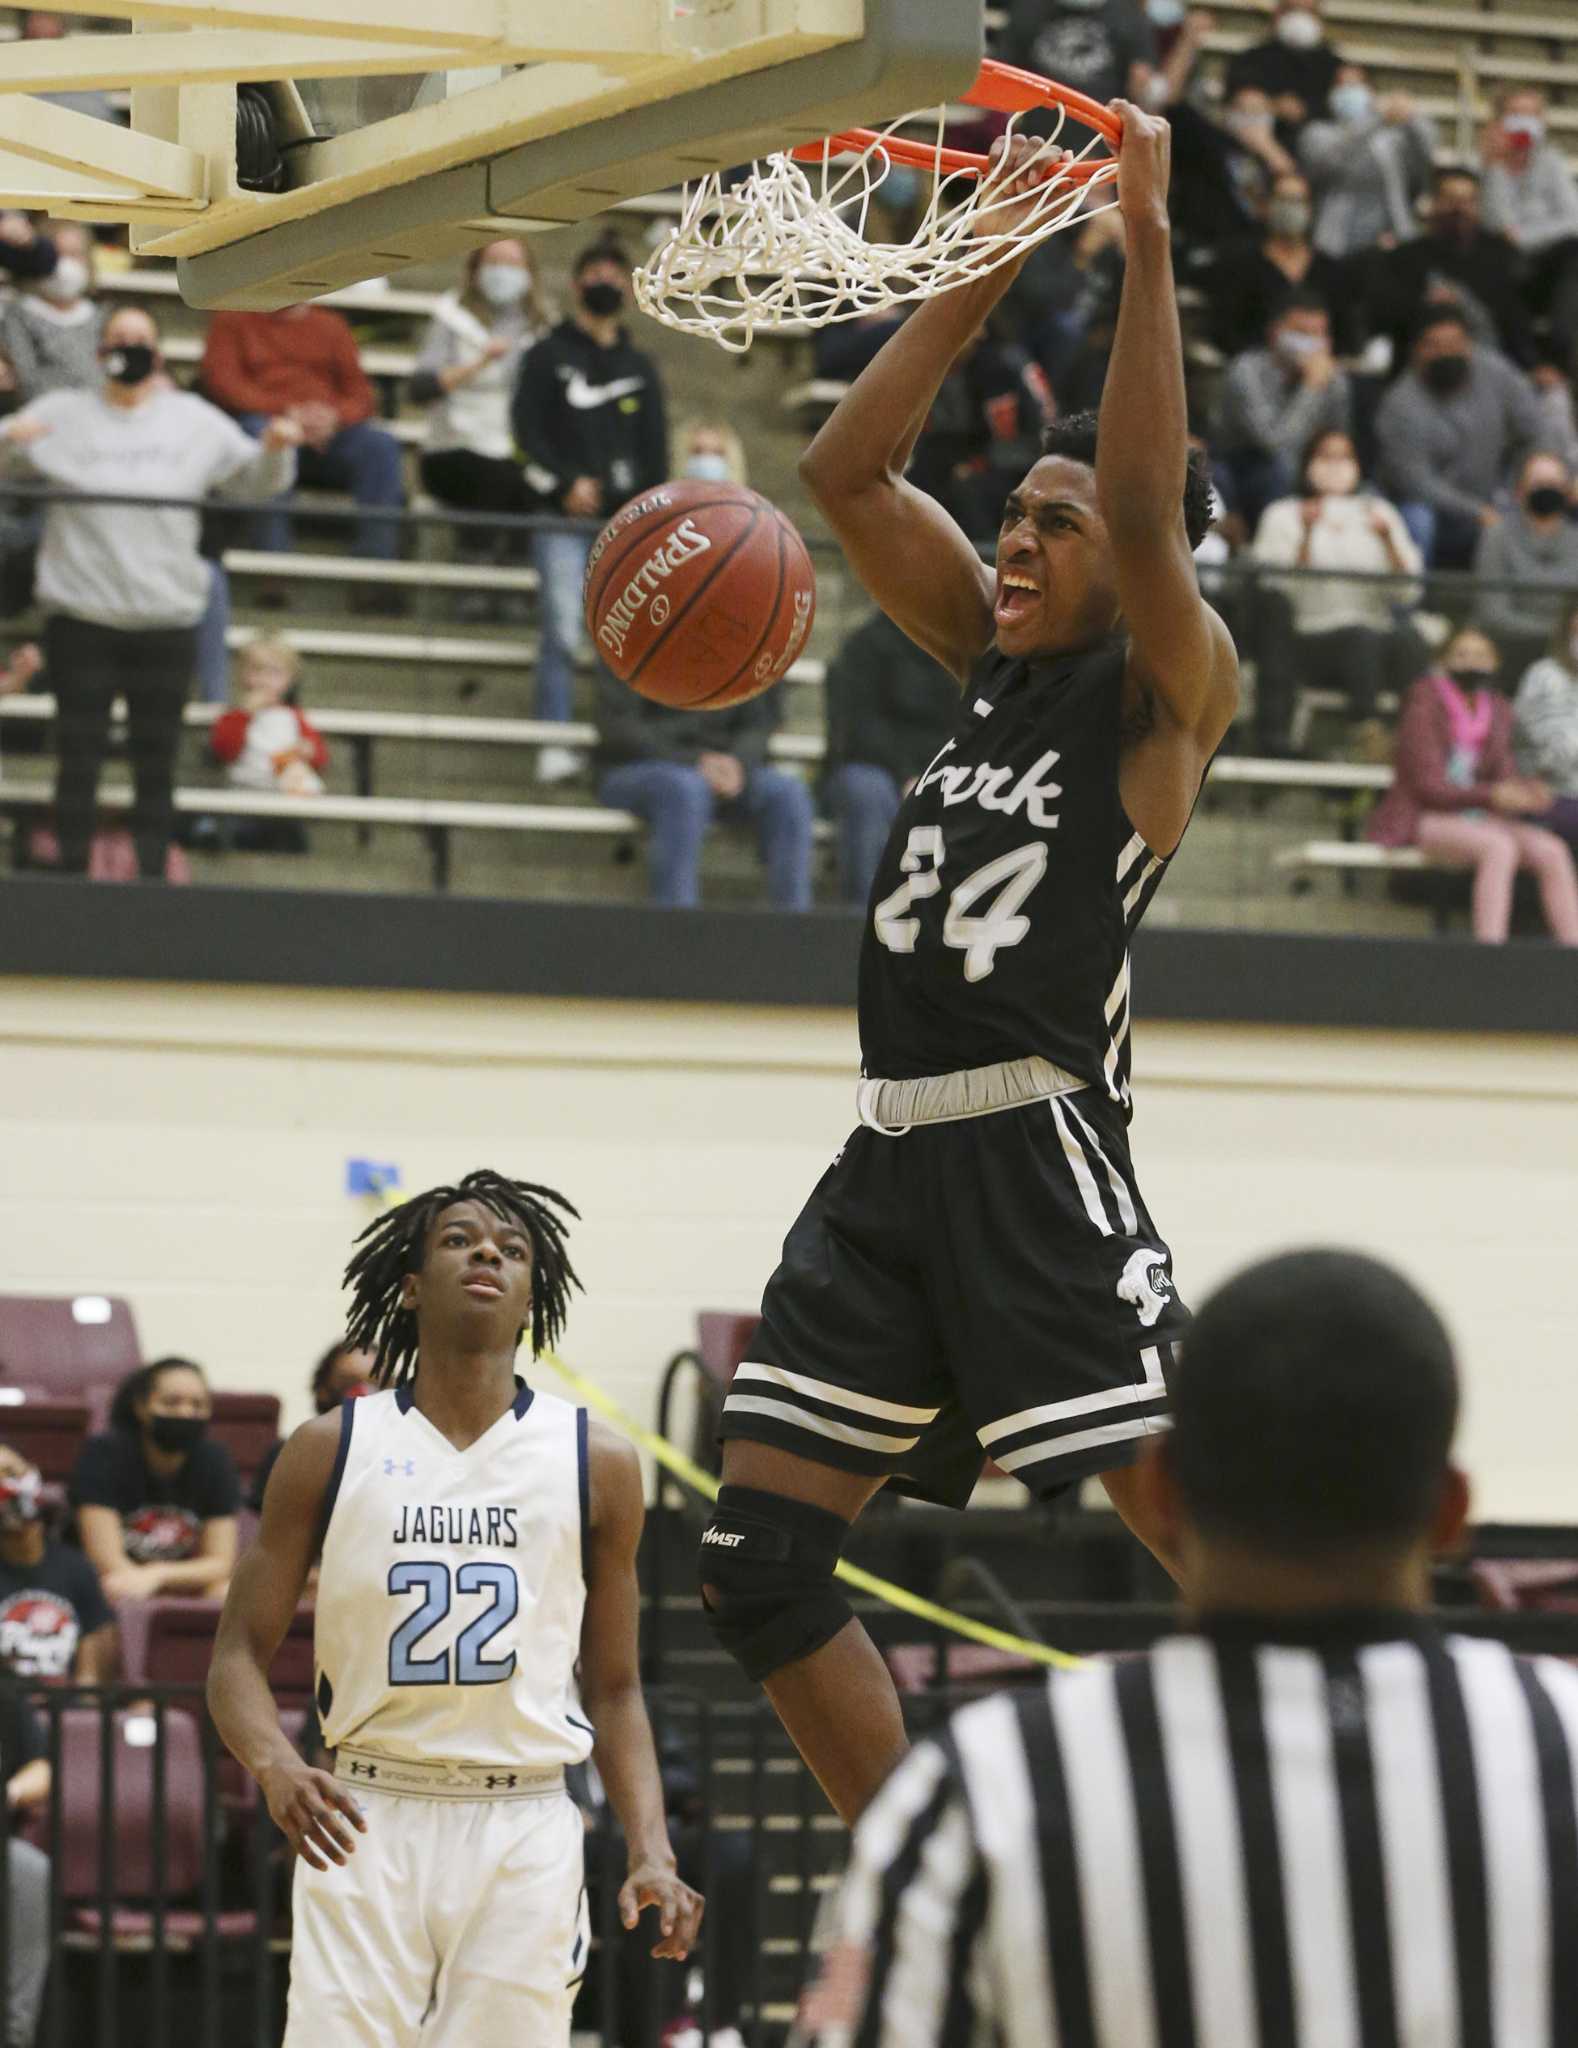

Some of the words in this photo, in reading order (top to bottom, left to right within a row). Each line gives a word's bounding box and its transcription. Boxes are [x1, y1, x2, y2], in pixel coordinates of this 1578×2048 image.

[599, 518, 712, 659] SPALDING
[874, 825, 1049, 983] 24
[393, 1505, 519, 1549] JAGUARS
[387, 1560, 519, 1687] 22
